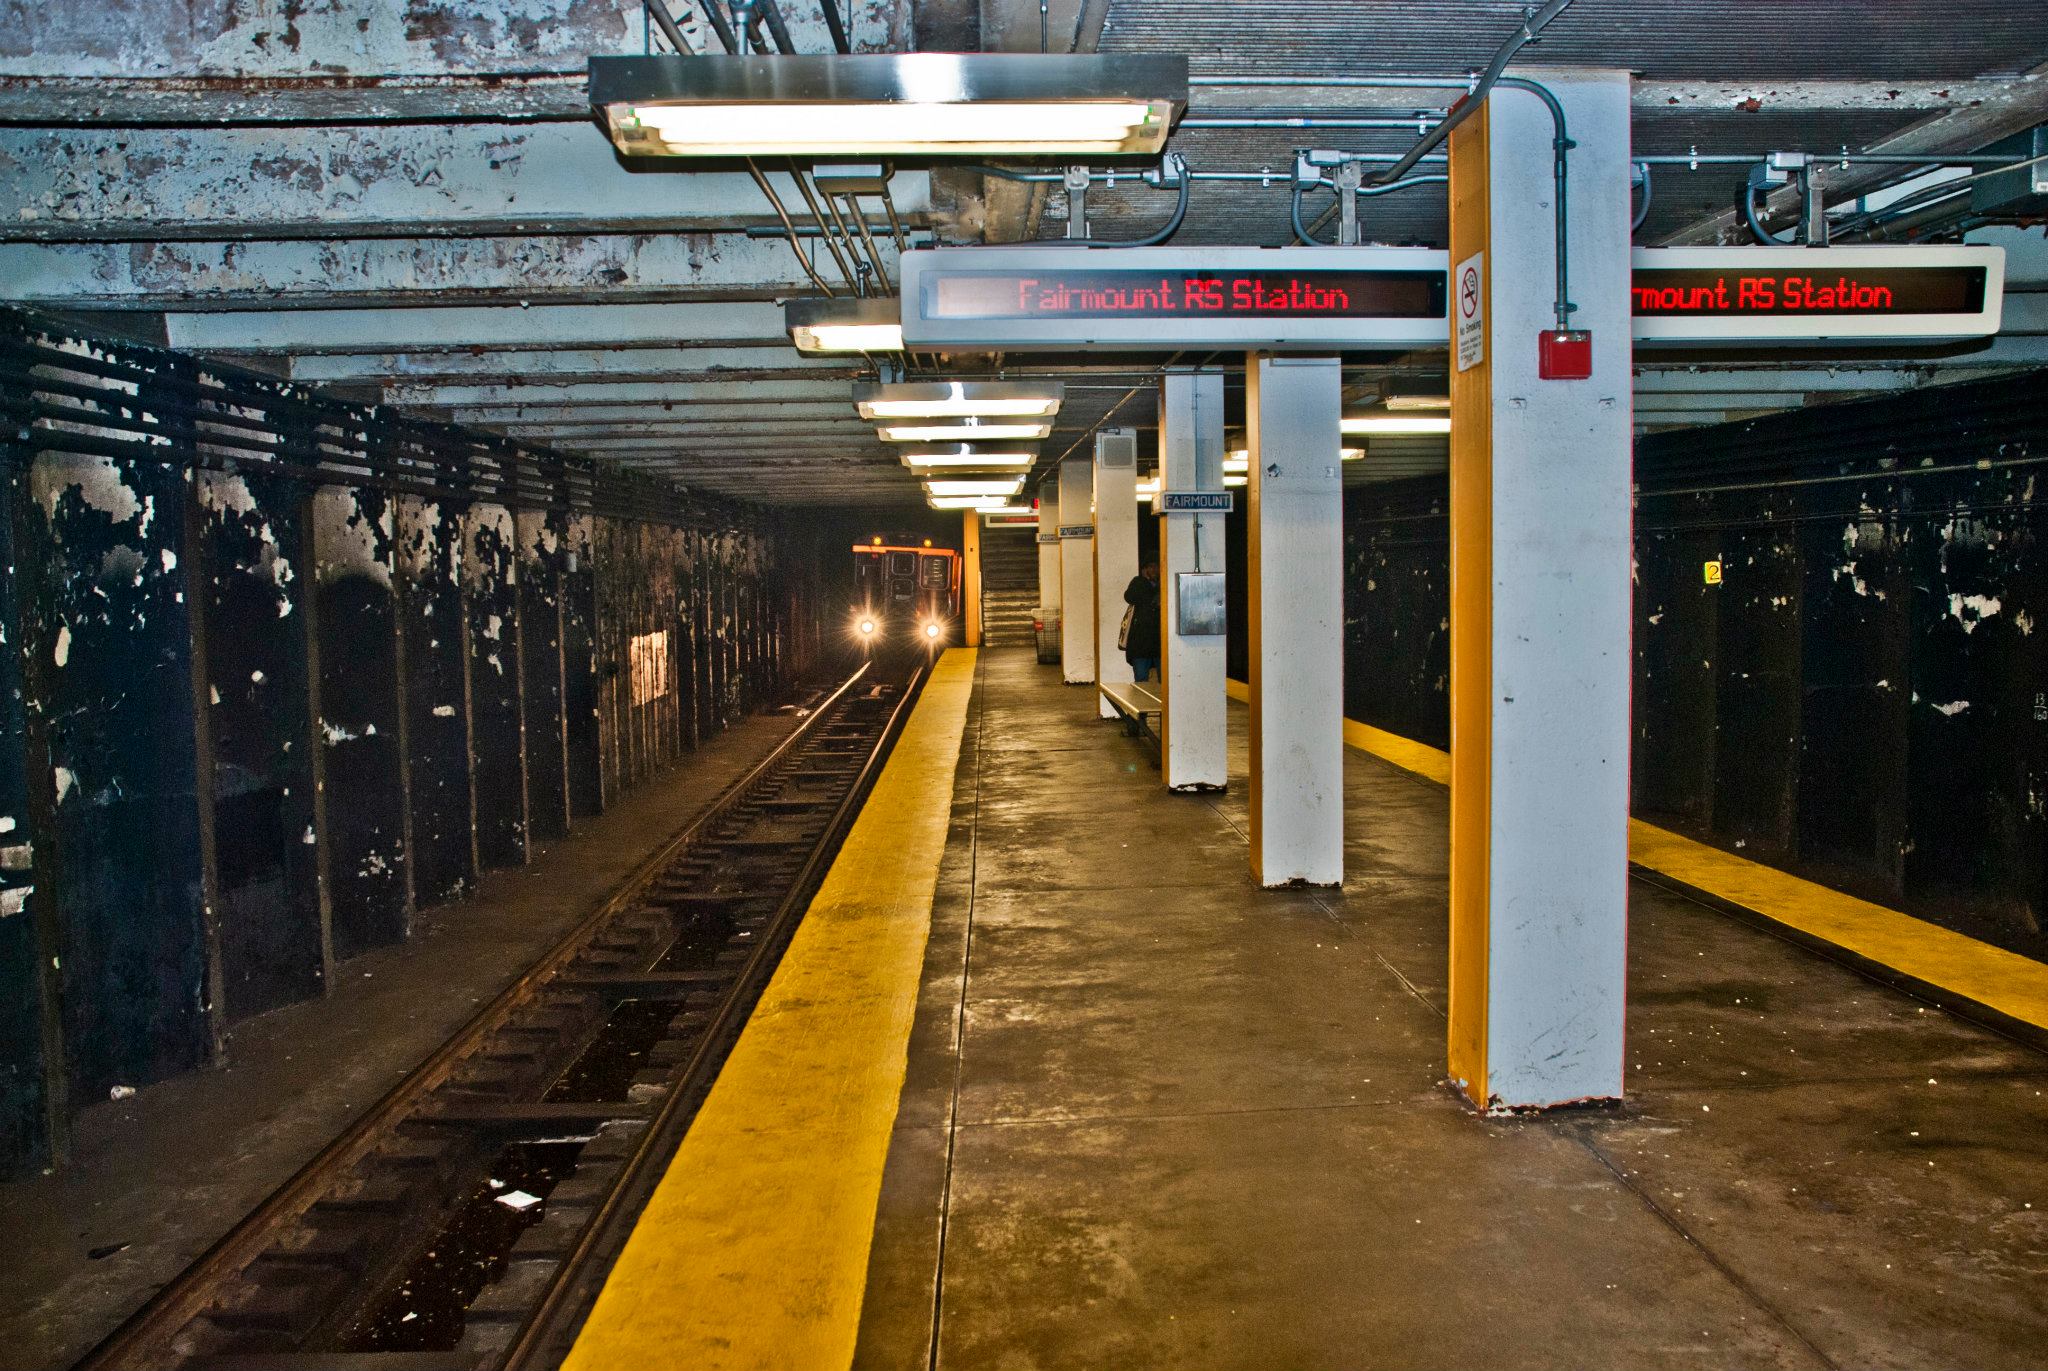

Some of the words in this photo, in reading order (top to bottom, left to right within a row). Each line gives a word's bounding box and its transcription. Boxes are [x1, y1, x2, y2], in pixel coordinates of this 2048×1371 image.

[1019, 279, 1176, 311] Fairmount
[1184, 279, 1224, 310] RS
[1232, 279, 1349, 310] Station
[1739, 277, 1775, 309] RS
[1783, 277, 1892, 308] Station
[1165, 495, 1229, 507] FAIRMOUNT
[1709, 565, 1720, 580] 2
[2035, 692, 2046, 706] 13
